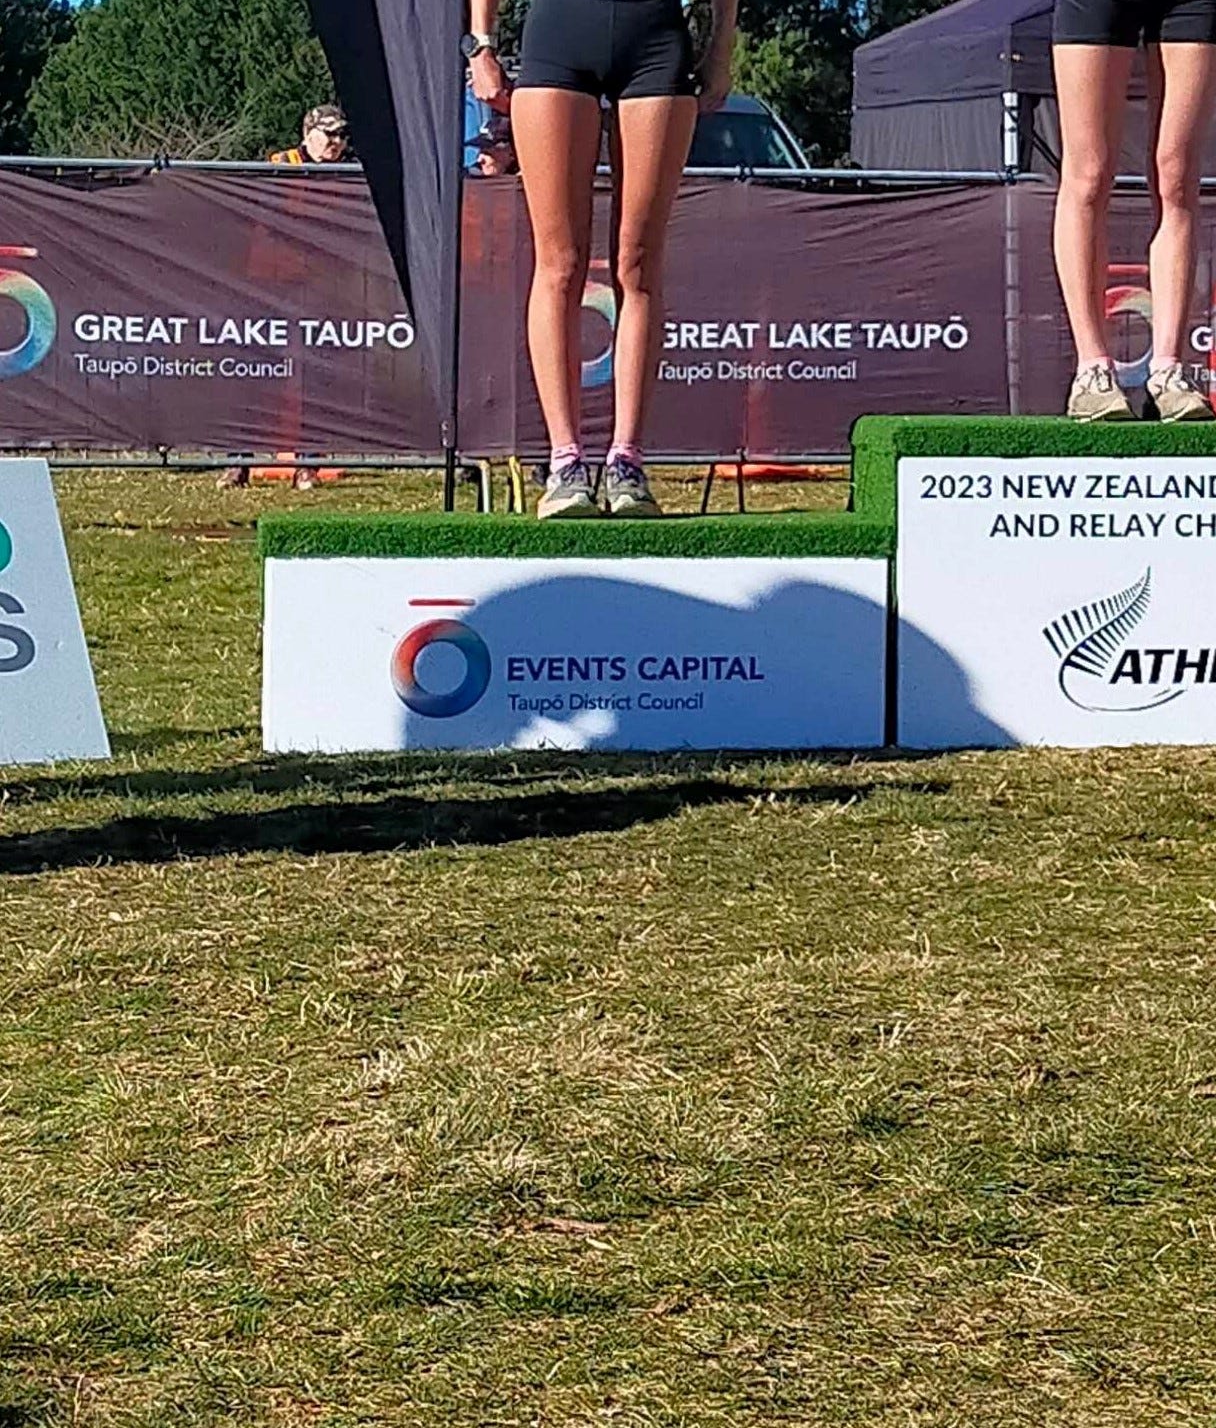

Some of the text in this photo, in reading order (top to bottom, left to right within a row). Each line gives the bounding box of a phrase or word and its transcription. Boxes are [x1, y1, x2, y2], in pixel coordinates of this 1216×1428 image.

[74, 313, 414, 349] GREAT LAKE TAUPŌ
[769, 323, 852, 349] LAKE
[861, 316, 969, 349] TAUPŌ
[74, 354, 293, 381] Taupō District Council
[718, 361, 783, 380] District
[788, 360, 857, 381] Council
[920, 475, 992, 499] 2023
[1001, 475, 1076, 499] NEW
[990, 514, 1060, 538] AND
[1070, 514, 1165, 538] RELAY
[507, 656, 764, 682] EVENTS CAPITAL
[570, 692, 632, 711] District
[638, 691, 704, 710] Council
